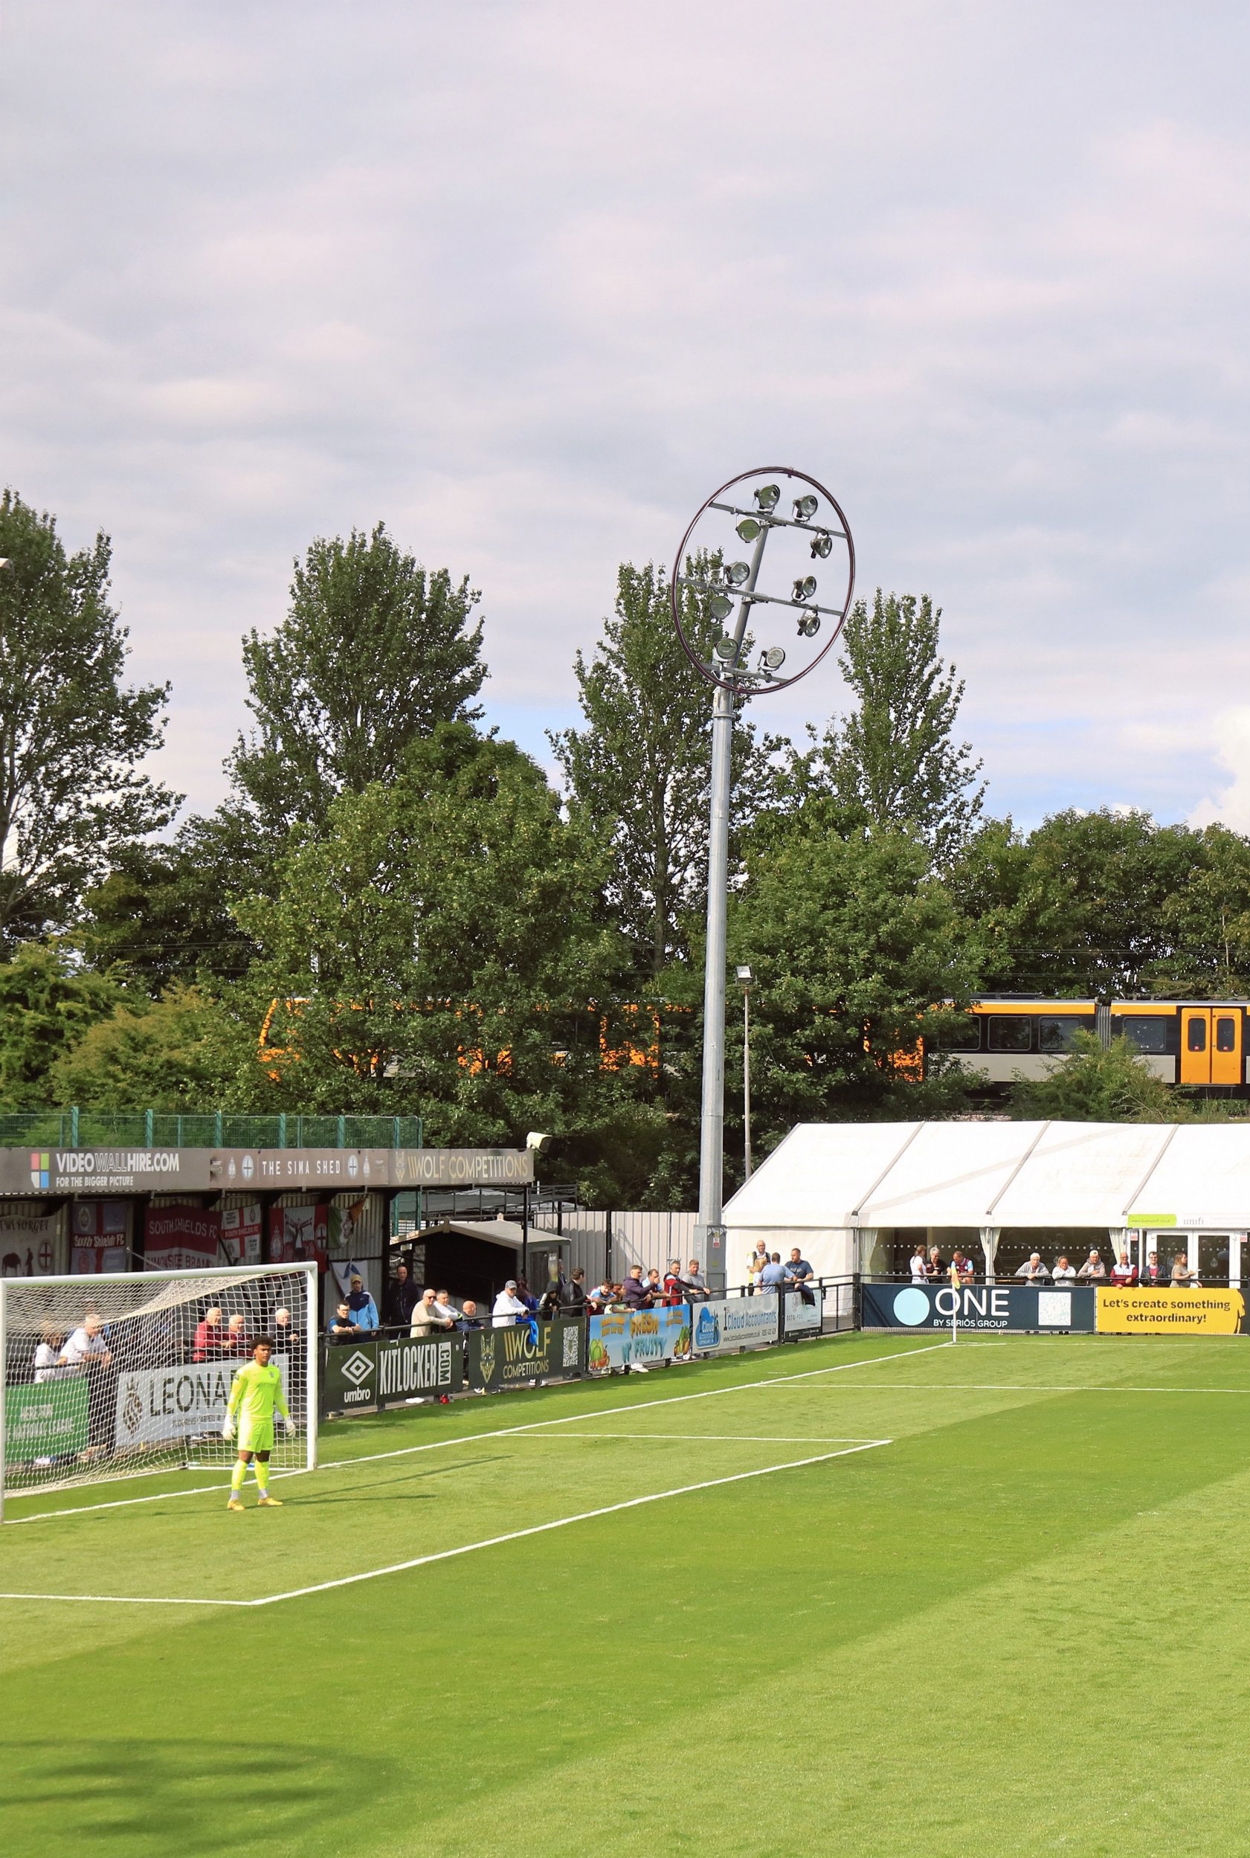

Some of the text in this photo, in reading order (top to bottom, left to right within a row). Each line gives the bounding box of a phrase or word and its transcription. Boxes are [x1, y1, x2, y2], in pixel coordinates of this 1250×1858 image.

[56, 1152, 180, 1173] VIDEOWALLHIRE.COM
[262, 1160, 281, 1175] THE
[316, 1159, 341, 1174] SHED
[449, 1155, 528, 1179] COMPETITIONS
[56, 1175, 134, 1188] FOR THE BIGGER PICTURE
[149, 1219, 173, 1236] SOUTH
[208, 1224, 218, 1240] FC
[116, 1233, 125, 1246] FC
[934, 1287, 1010, 1317] ONE
[1103, 1298, 1231, 1312] Let's create something
[933, 1319, 944, 1327] BY
[977, 1319, 1008, 1328] GROUP
[1126, 1313, 1207, 1324] extraordinary!
[379, 1343, 437, 1395] KITLOCKER
[502, 1358, 549, 1380] COMPETITIONS
[343, 1387, 371, 1404] umbro
